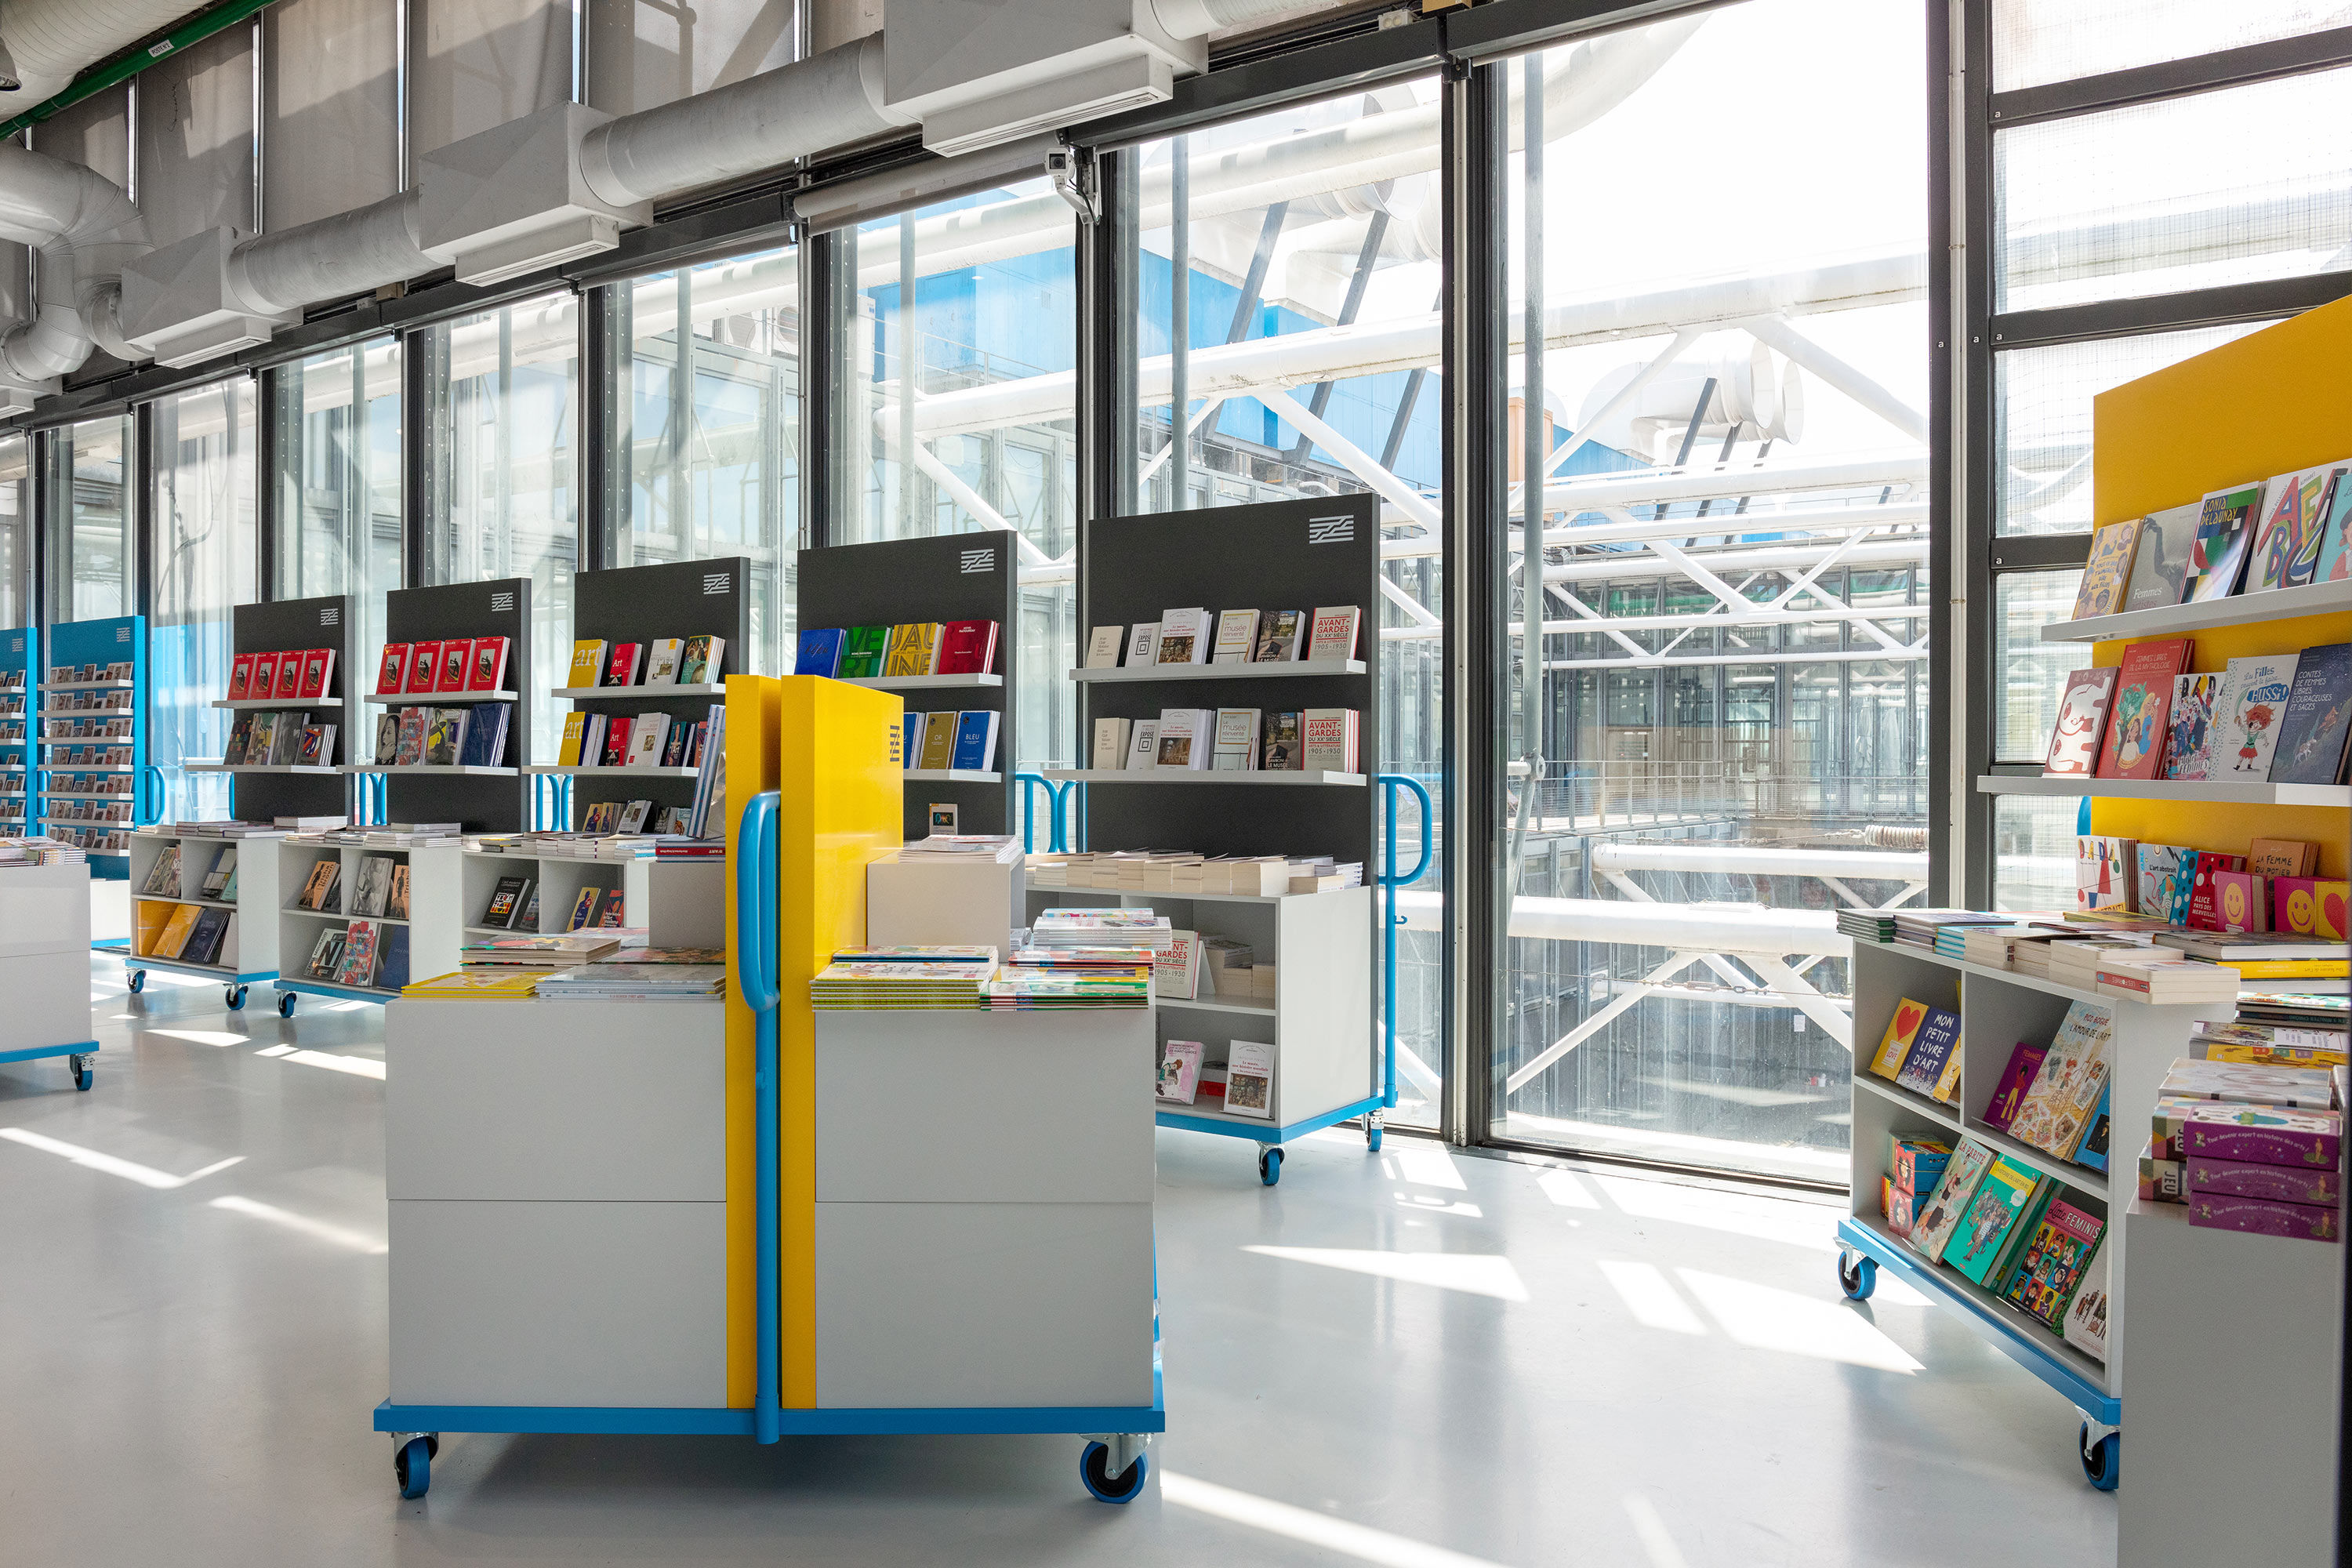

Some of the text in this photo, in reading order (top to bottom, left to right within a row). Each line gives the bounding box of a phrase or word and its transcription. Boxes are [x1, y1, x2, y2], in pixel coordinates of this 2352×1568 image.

[2203, 497, 2227, 514] SONIA
[2200, 508, 2238, 526] DELAUNAY
[2133, 587, 2163, 599] Femmes
[1317, 618, 1350, 626] AVANT-
[575, 646, 601, 666] art
[2255, 666, 2275, 678] Filles
[2298, 670, 2321, 679] CONTES
[2304, 677, 2327, 686] FEMMES
[2292, 693, 2332, 702] COURAGEUSES
[566, 718, 585, 739] art
[2078, 838, 2116, 862] DADA
[2266, 855, 2292, 866] FEMME
[2266, 867, 2291, 877] POTIER
[2194, 895, 2211, 904] ALICE
[1156, 950, 1188, 960] GARDES
[1933, 1014, 1955, 1029] MON
[2084, 1013, 2110, 1026] PICO BOGUE
[1926, 1027, 1951, 1044] PETIT
[2070, 1024, 2111, 1042] L'AMOUR DE L'ART
[1886, 1051, 1898, 1060] LOVE
[1919, 1040, 1944, 1058] LIVRE
[2023, 1049, 2042, 1061] FEMMES
[1913, 1054, 1938, 1073] D'ART
[2285, 1138, 2293, 1146] des
[1958, 1142, 1987, 1165] LA PARITÉ
[2164, 1171, 2176, 1192] JEU
[2049, 1203, 2066, 1220] Little
[2064, 1212, 2101, 1239] FEMINIS
